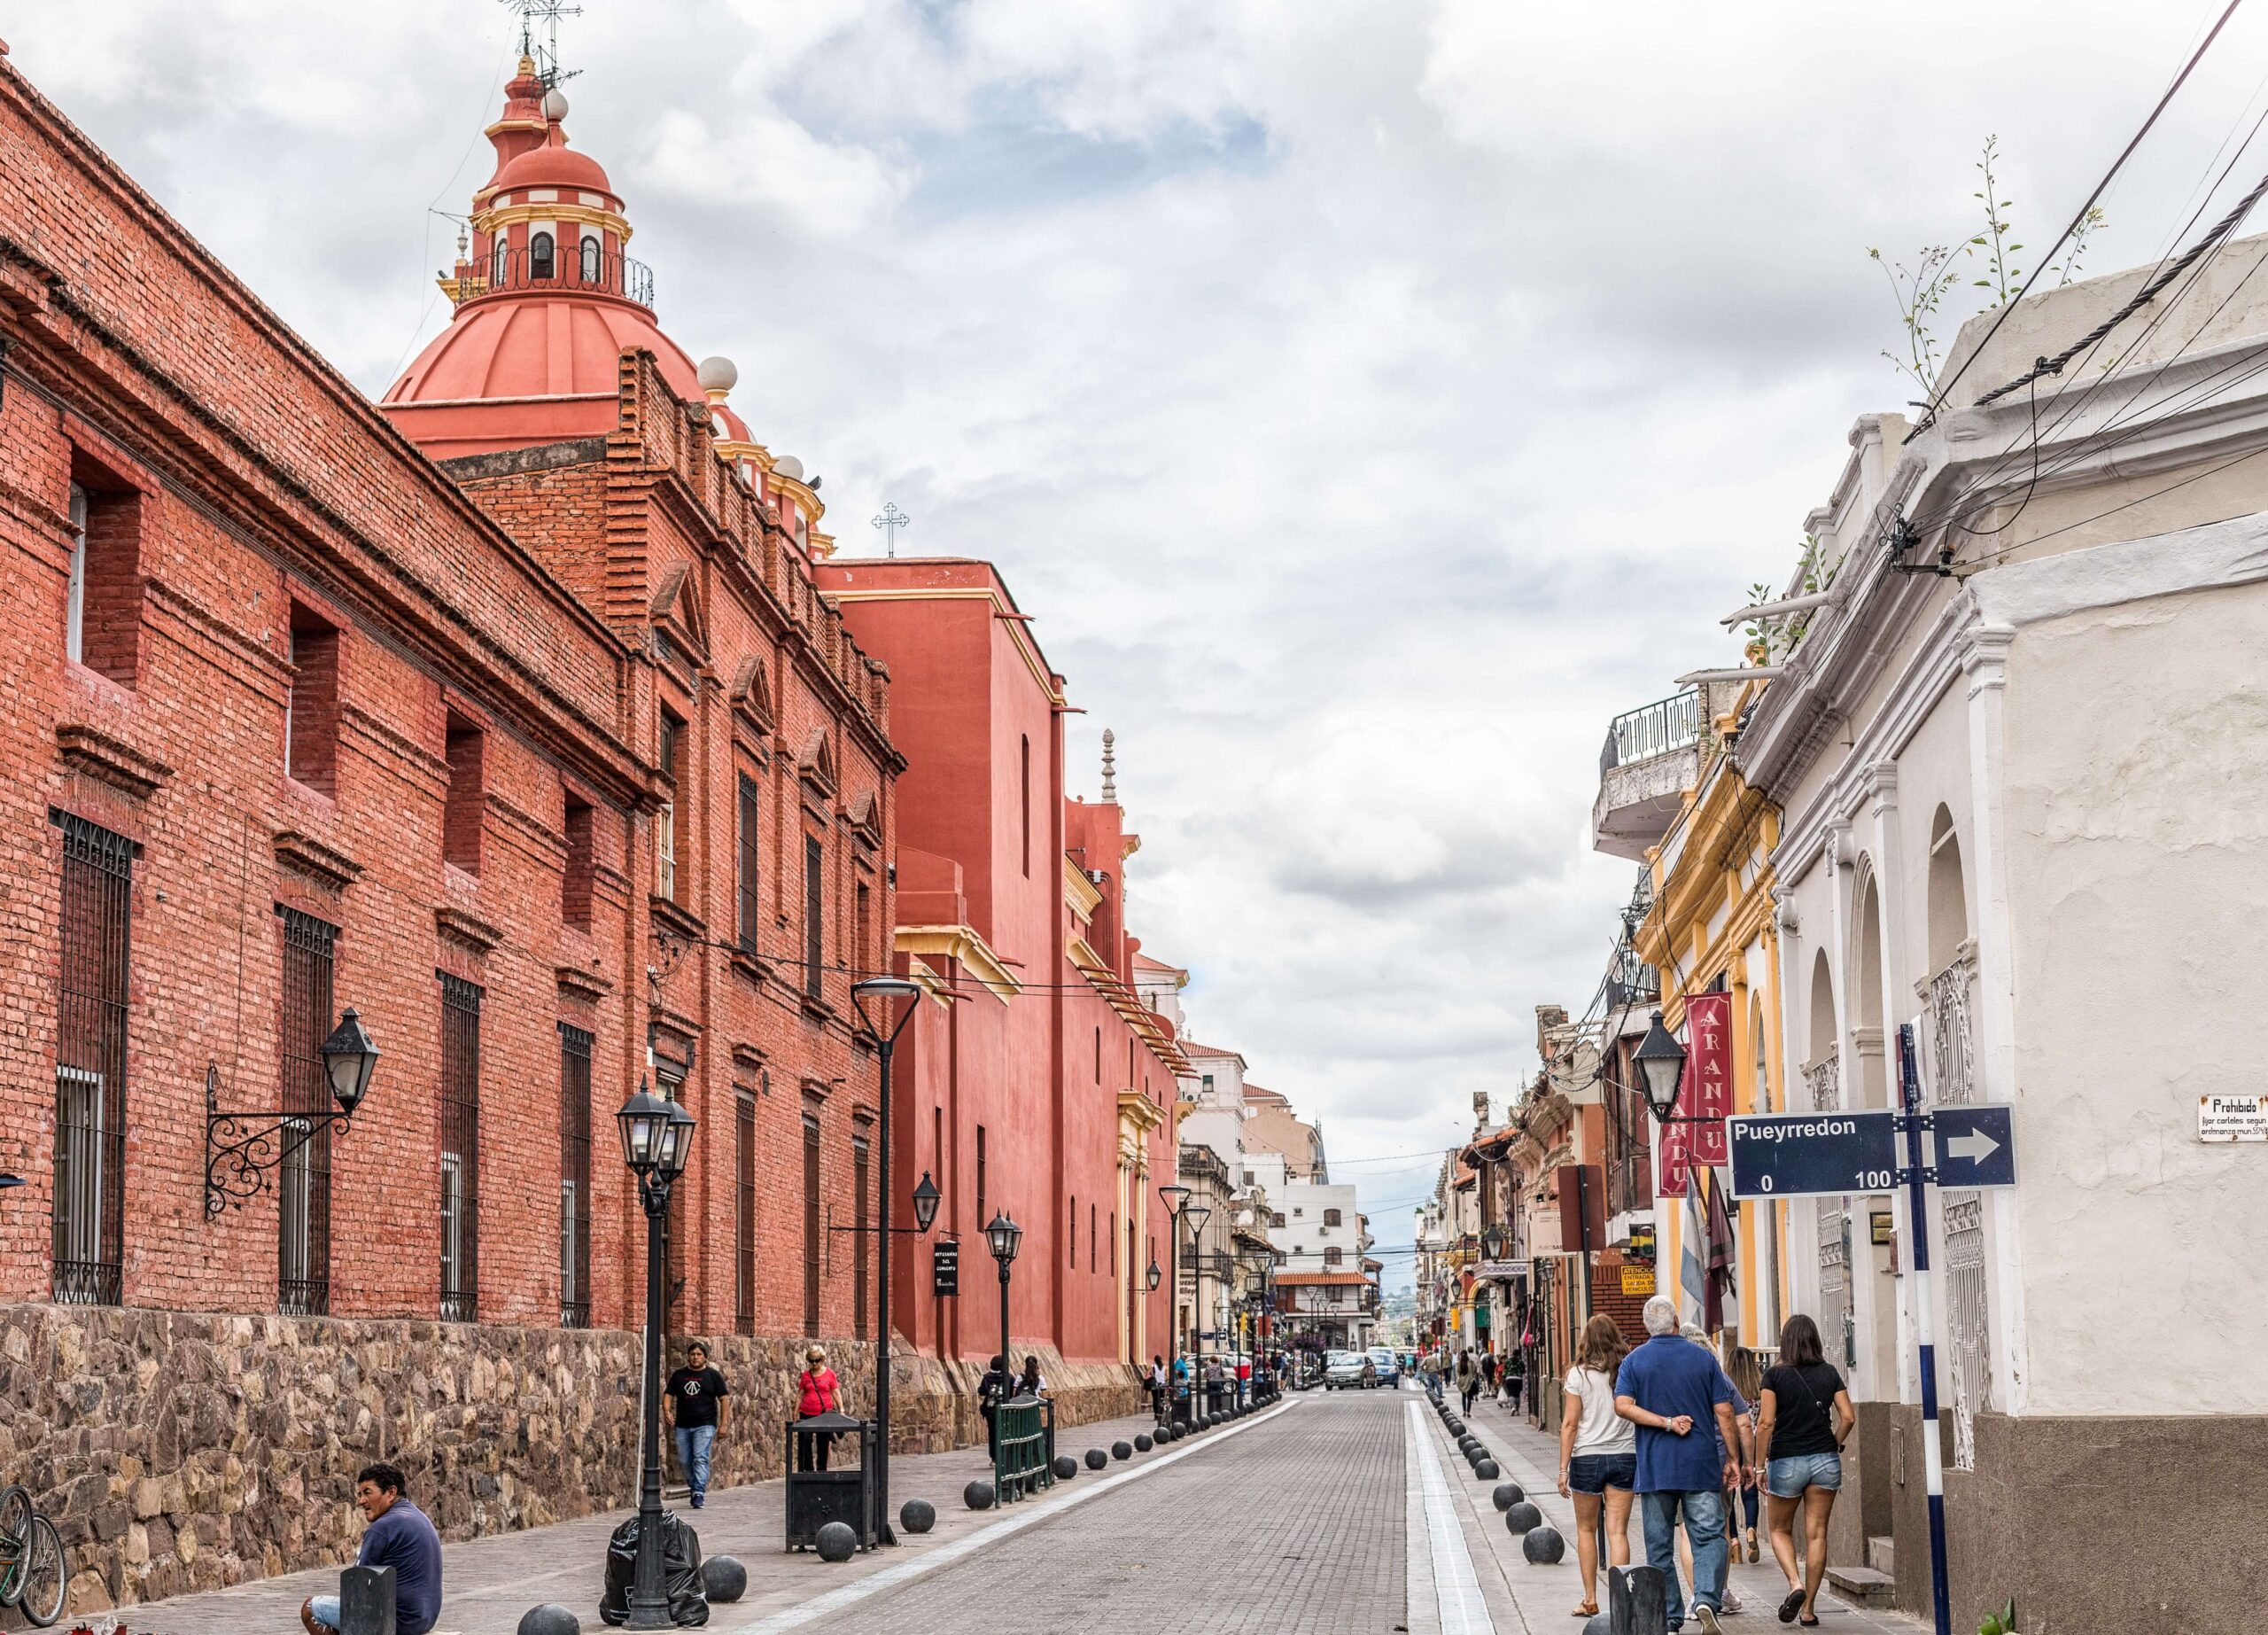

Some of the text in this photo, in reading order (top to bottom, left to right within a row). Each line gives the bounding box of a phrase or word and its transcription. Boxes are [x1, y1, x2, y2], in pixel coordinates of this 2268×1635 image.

[1700, 1009, 1724, 1148] ARANDU
[2213, 1098, 2257, 1113] Prohibido
[1735, 1118, 1856, 1143] Pueyrredon
[2202, 1117, 2215, 1126] fijar
[1761, 1170, 1891, 1193] 0 100
